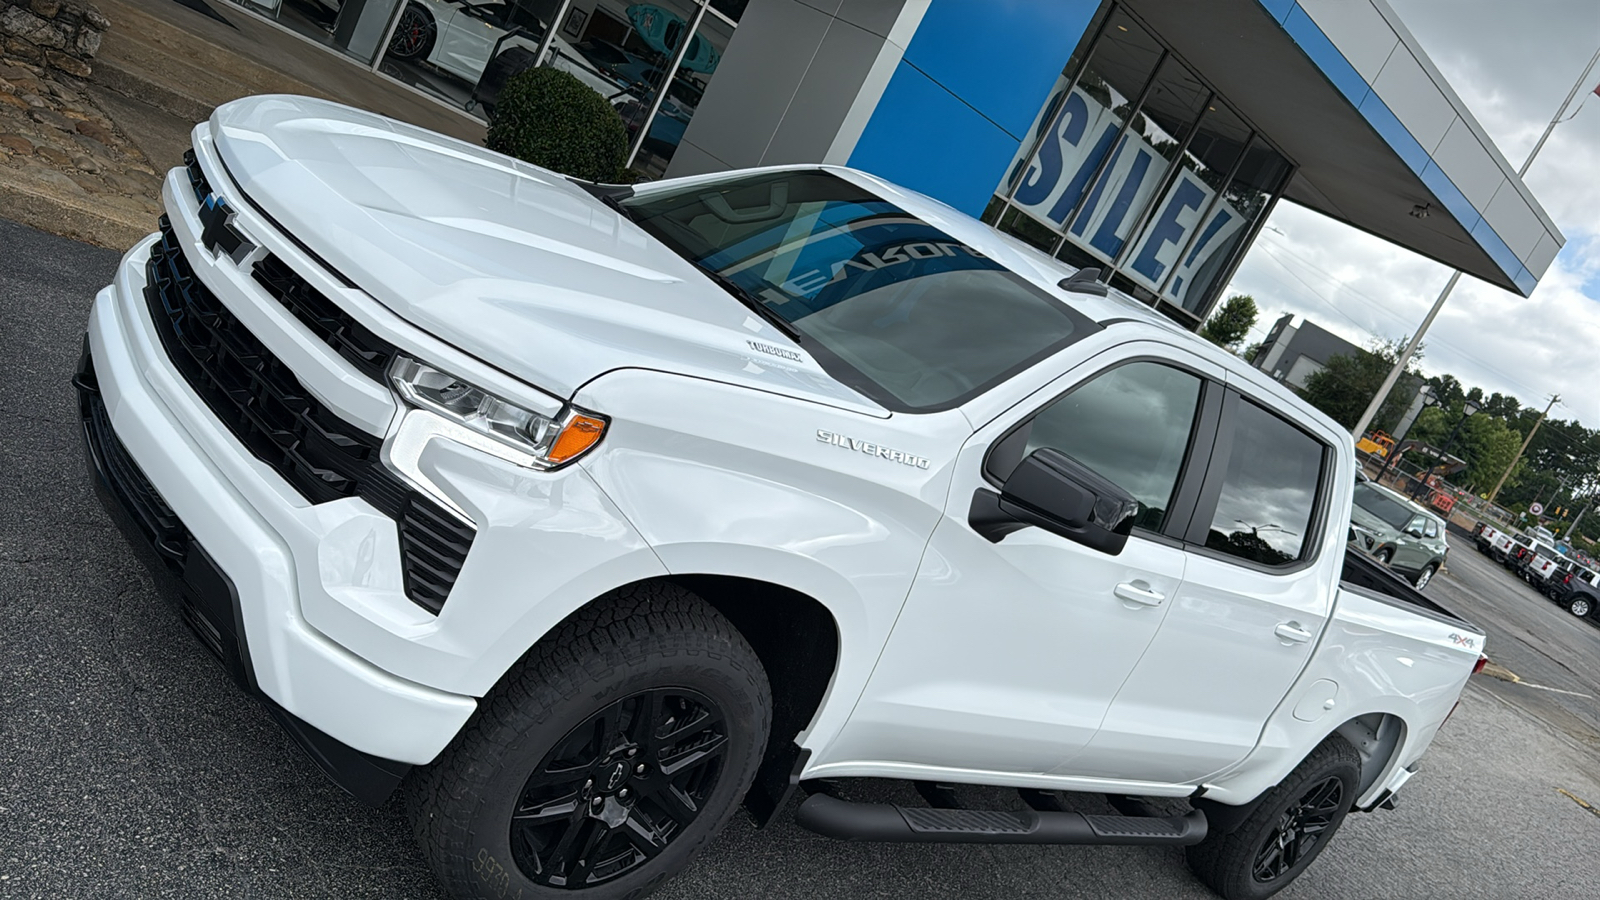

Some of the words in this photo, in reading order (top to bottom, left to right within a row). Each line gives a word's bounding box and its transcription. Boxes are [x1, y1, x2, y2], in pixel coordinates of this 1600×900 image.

[1008, 90, 1233, 298] SALE!
[746, 340, 803, 363] TURBOMAX
[816, 428, 931, 470] SILVERADO
